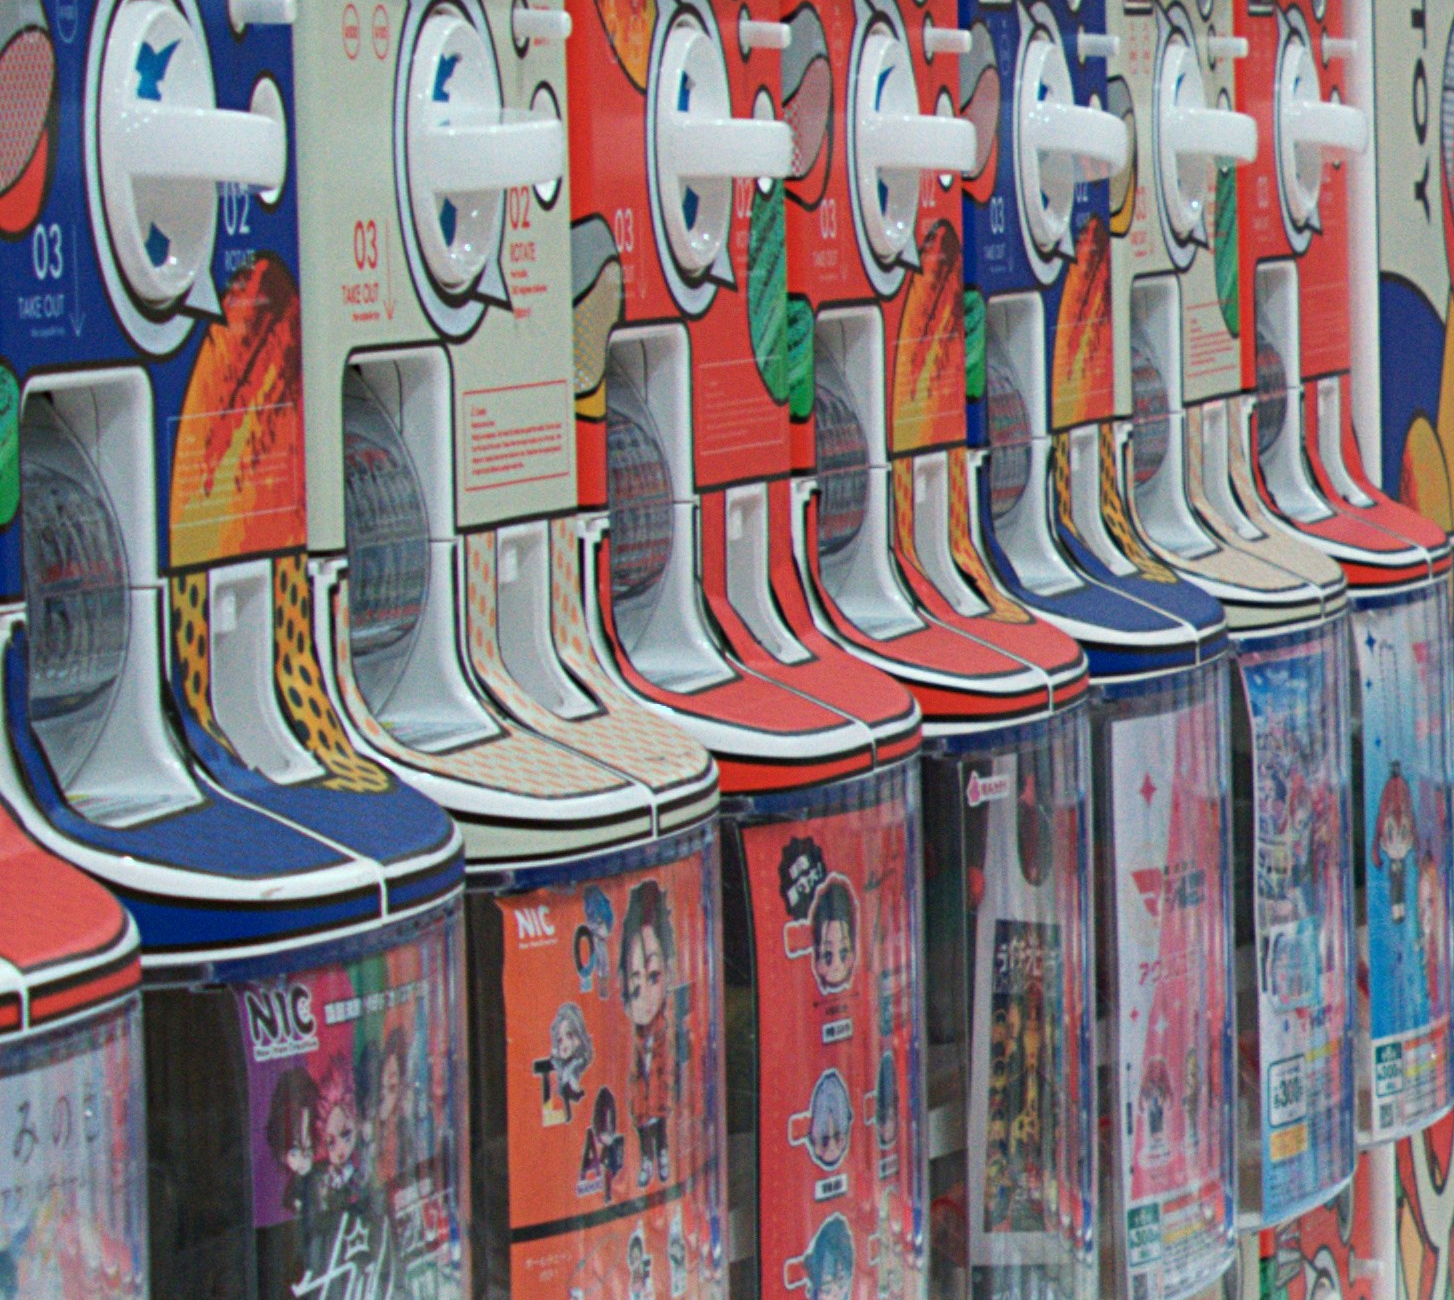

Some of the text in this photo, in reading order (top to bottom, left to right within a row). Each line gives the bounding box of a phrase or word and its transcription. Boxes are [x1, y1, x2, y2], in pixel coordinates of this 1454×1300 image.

[510, 189, 530, 229] 02
[33, 224, 63, 279] 03
[354, 220, 377, 270] 03
[509, 243, 536, 262] ROTATE
[18, 297, 66, 319] TAKE OUT
[341, 283, 379, 304] TAKE OUT
[515, 906, 556, 941] NIC
[246, 983, 315, 1045] NIC
